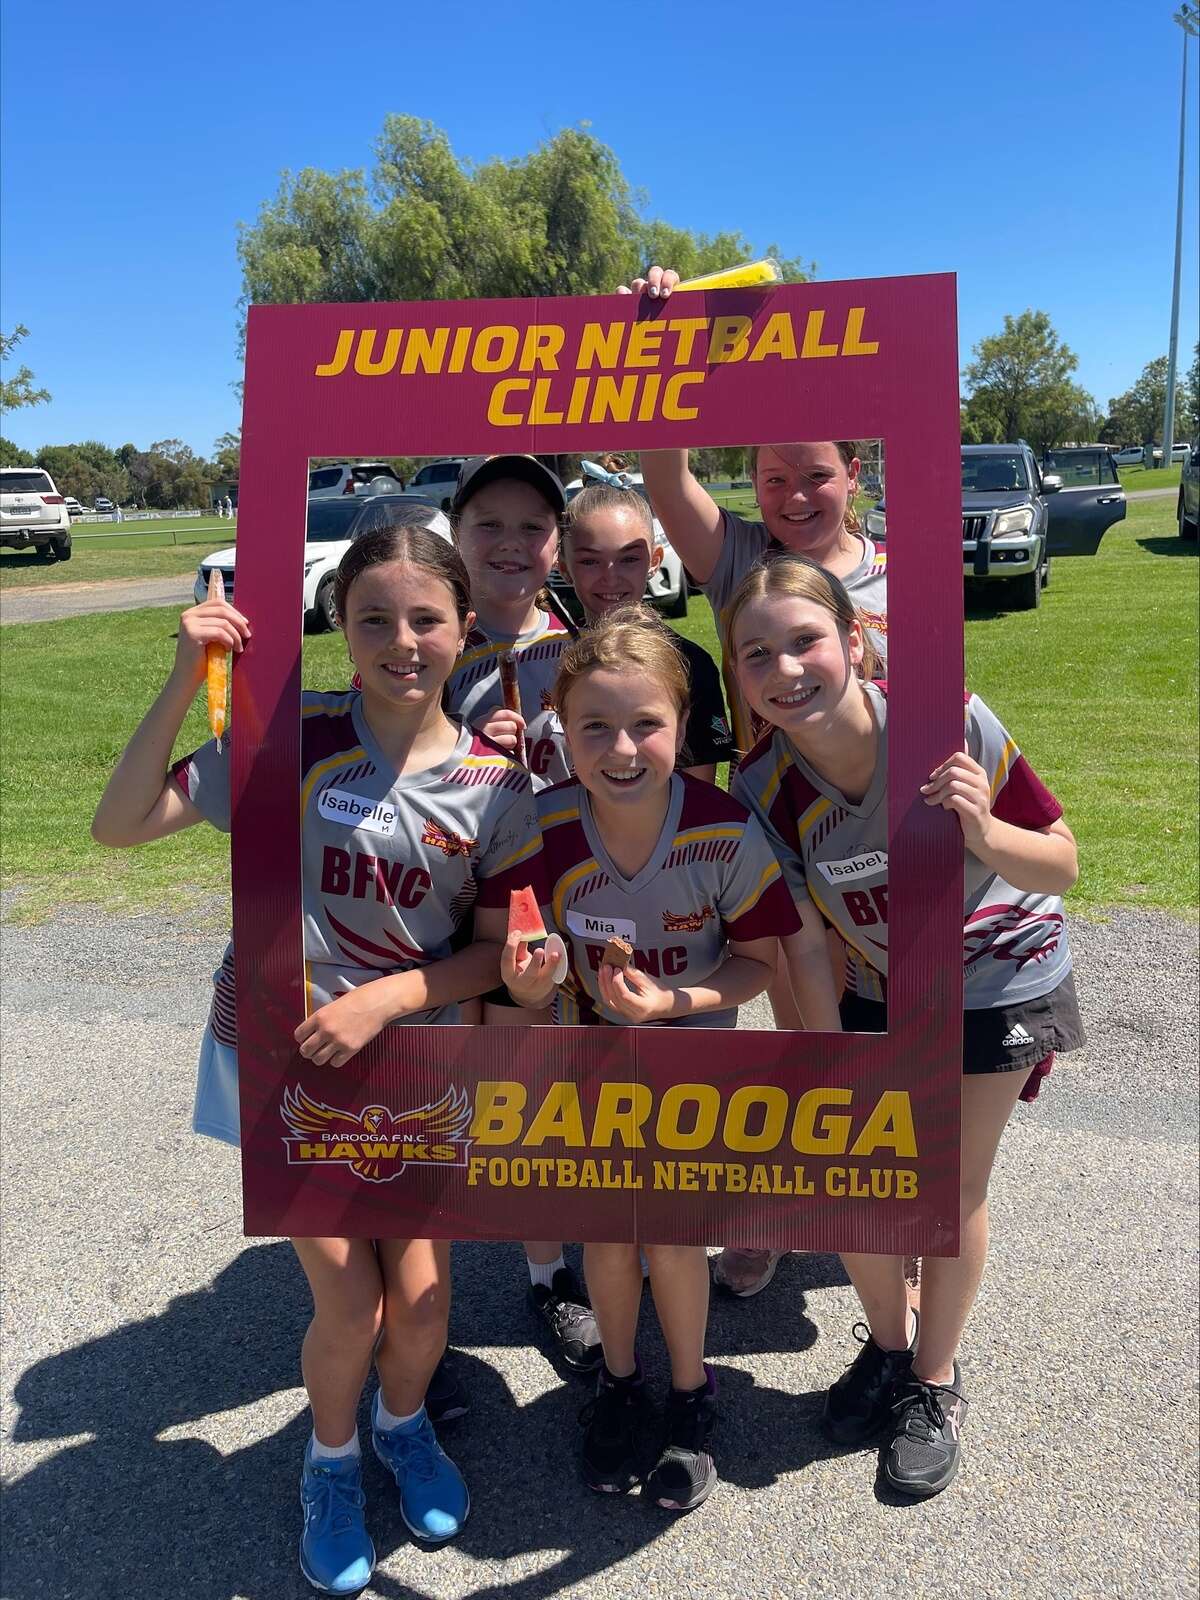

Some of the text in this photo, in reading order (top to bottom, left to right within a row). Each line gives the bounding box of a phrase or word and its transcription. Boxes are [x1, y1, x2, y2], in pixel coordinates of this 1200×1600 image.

[315, 307, 880, 376] JUNIOR NETBALL
[486, 371, 705, 426] CLINIC
[321, 791, 394, 823] Isabelle
[321, 845, 432, 909] BFNC
[826, 853, 882, 876] Isabel
[841, 884, 888, 927] BF
[585, 918, 615, 933] Mia
[584, 944, 688, 978] BNC
[1002, 1036, 1034, 1047] adidas
[468, 1080, 919, 1158] BAROOGA
[300, 1143, 457, 1160] HAWKS
[321, 1133, 428, 1143] BAROOGA F.N.C.
[467, 1156, 919, 1199] FOOTBALL NETBALL CLUB
